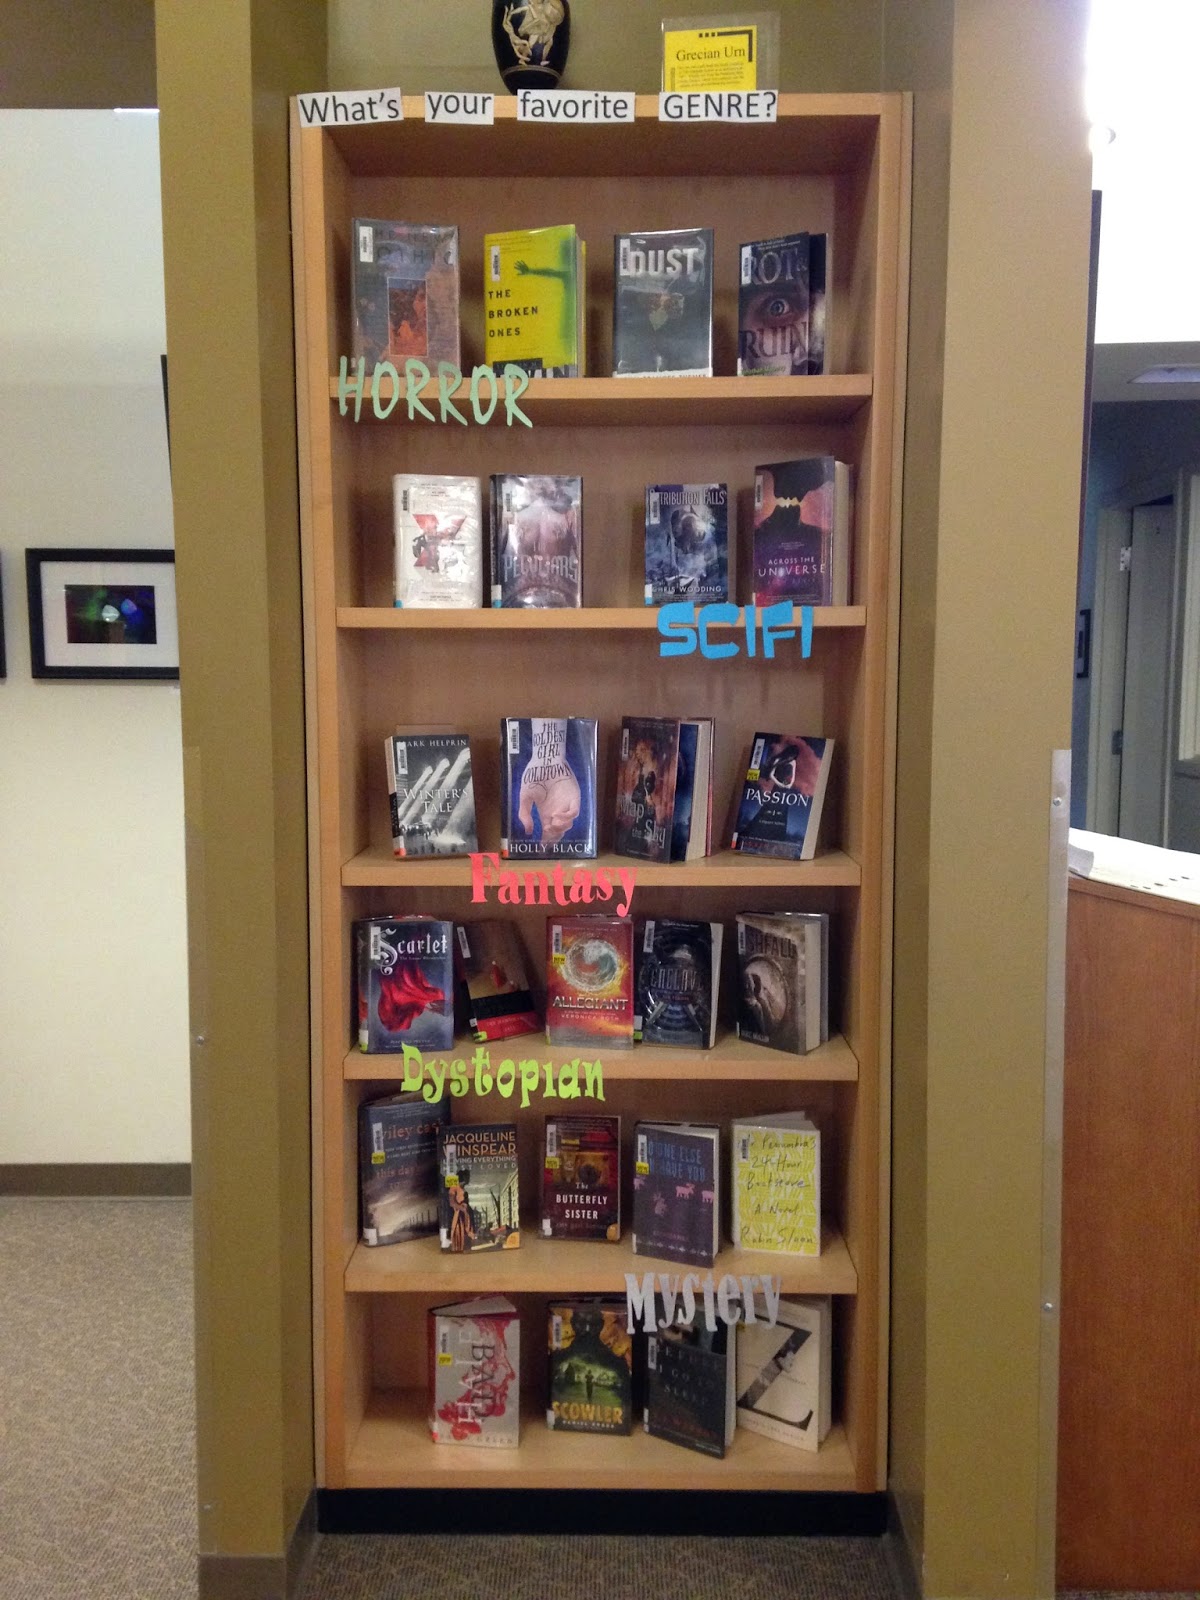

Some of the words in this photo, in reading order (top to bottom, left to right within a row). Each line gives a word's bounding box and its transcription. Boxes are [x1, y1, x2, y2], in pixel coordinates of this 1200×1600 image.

[676, 48, 720, 62] Grecian
[724, 46, 746, 58] Urn
[300, 92, 399, 124] What's
[427, 93, 492, 121] your
[519, 92, 629, 119] favorite
[663, 92, 778, 119] GENRE?
[488, 289, 511, 299] THE
[489, 306, 539, 319] BROKEN
[489, 327, 521, 338] ONES
[740, 322, 811, 359] RUIN
[337, 355, 533, 428] HORROR
[650, 489, 699, 506] TRIBUTION
[768, 557, 798, 565] ACROSS
[758, 563, 826, 577] UNIVERSE
[679, 585, 722, 593] WOODING
[429, 739, 467, 747] HELPRIN
[537, 744, 560, 760] GIRL
[543, 757, 552, 766] IN
[523, 764, 573, 785] COLDTOWN
[403, 788, 468, 800] WINTER'S
[745, 788, 810, 807] PASSION
[421, 800, 453, 813] TALE
[510, 843, 548, 854] HOLLY
[553, 843, 592, 854] BLACK
[468, 852, 638, 918] Fantasy
[376, 927, 448, 975] Scarlet
[552, 995, 628, 1011] ALLEGIANT
[400, 1042, 605, 1108] Dystopian
[443, 1131, 516, 1145] JACQUELINE
[443, 1143, 517, 1157] INSPEAR
[555, 1194, 608, 1205] BUTTERFLY
[564, 1209, 599, 1220] SISTER
[769, 1202, 799, 1215] Novel
[624, 1271, 782, 1335] Mystery
[552, 1400, 623, 1425] SCOWLER
